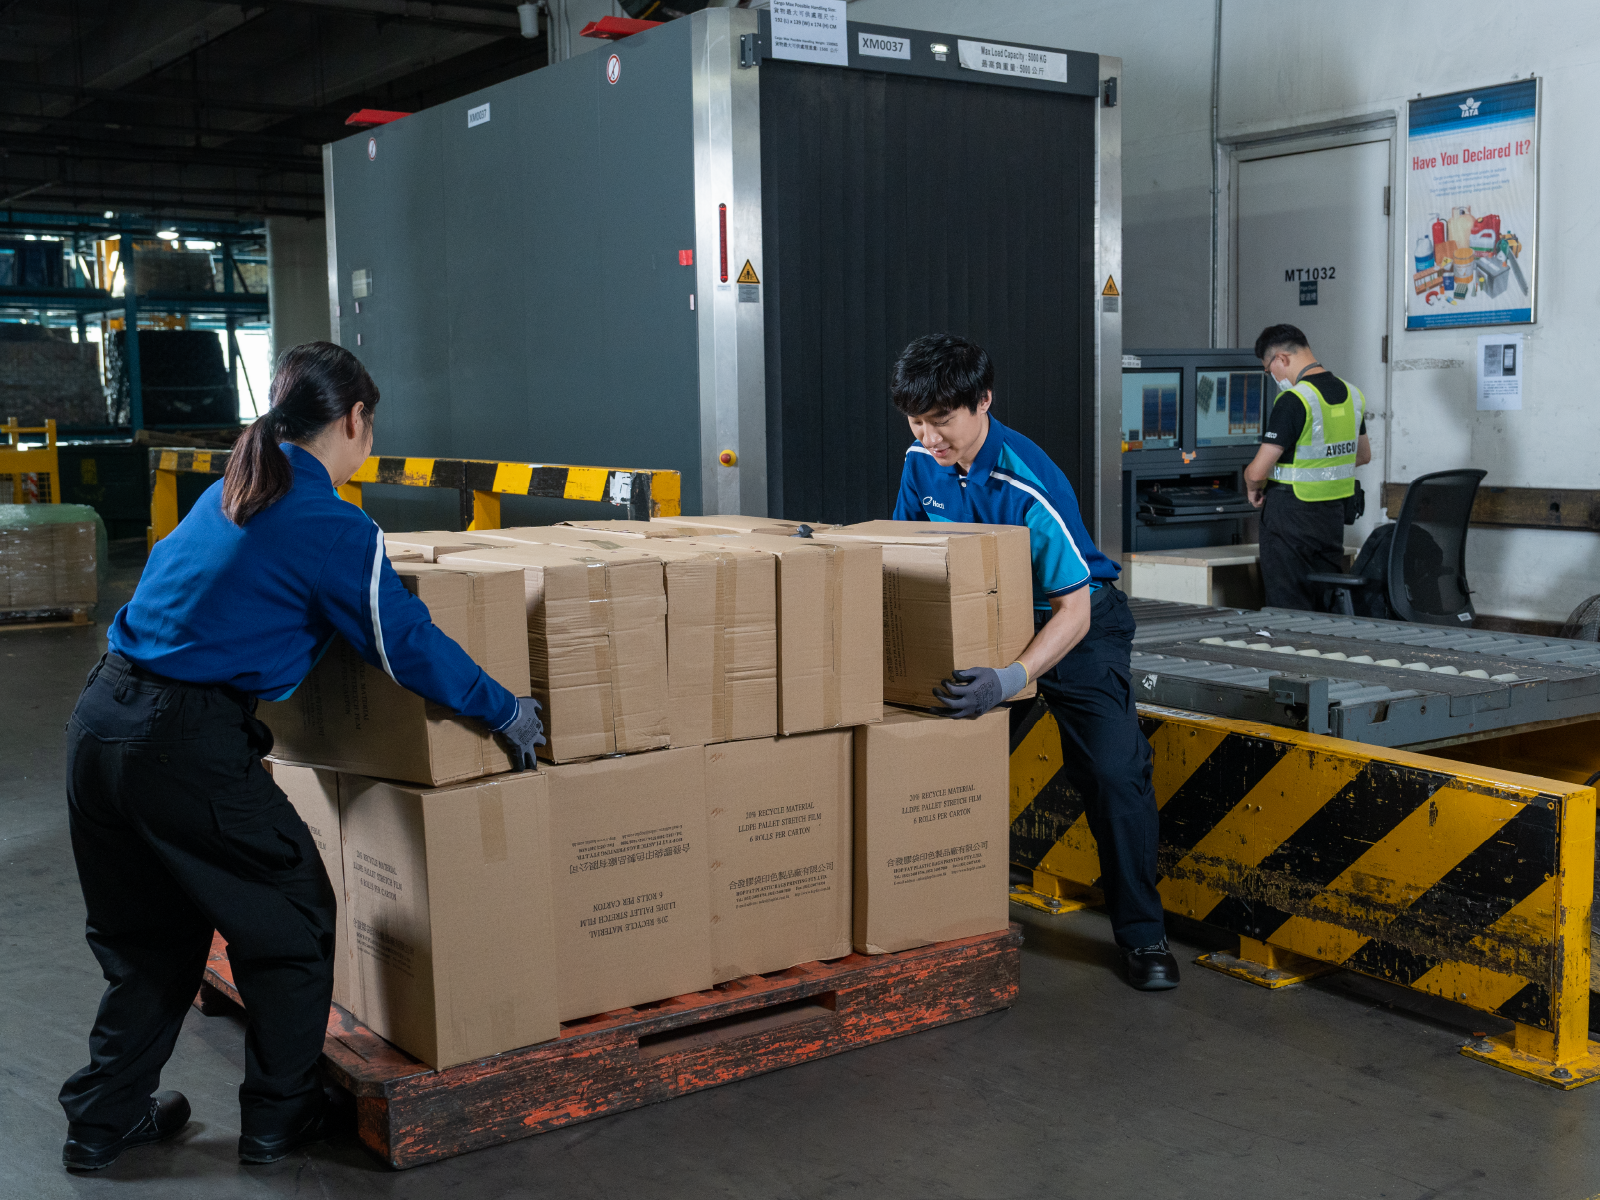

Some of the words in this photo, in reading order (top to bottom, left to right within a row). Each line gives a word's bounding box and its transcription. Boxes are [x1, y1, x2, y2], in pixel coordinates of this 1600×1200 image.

[862, 37, 903, 53] XM0037
[981, 46, 990, 55] Max
[992, 48, 1003, 58] Load
[1004, 50, 1024, 62] Capacity
[1461, 109, 1478, 118] IATA
[1413, 156, 1437, 171] Have
[1440, 152, 1458, 166] You
[1463, 142, 1511, 163] Declared
[1515, 139, 1531, 156] It?
[1284, 267, 1336, 282] MT1032
[1326, 442, 1356, 456] AVSECO
[922, 789, 946, 800] RECYCLE
[948, 784, 975, 795] MATERIAL
[758, 807, 784, 817] RECYCLE
[786, 802, 815, 813] MATERIAL
[922, 801, 942, 811] PALLET
[943, 797, 967, 808] STRETCH
[968, 794, 982, 803] FILM
[738, 823, 756, 833] LLDPE
[758, 820, 780, 830] PALLET
[781, 815, 806, 826] STRETCH
[808, 813, 822, 821] FILM
[919, 814, 936, 824] ROLLS
[937, 812, 948, 820] PER
[949, 808, 971, 818] CARTON
[755, 833, 773, 842] ROLLS
[775, 830, 786, 839] PER
[788, 827, 810, 837] CARTON
[623, 897, 634, 906] PER
[637, 893, 657, 903] ROLLS
[593, 900, 620, 912] CARTON
[630, 906, 654, 916] PALLET
[656, 902, 676, 912] LLDPE
[580, 917, 597, 928] FILM
[599, 911, 628, 924] STRETCH
[589, 925, 623, 938] MATERIAL
[625, 919, 654, 931] RECYCLE
